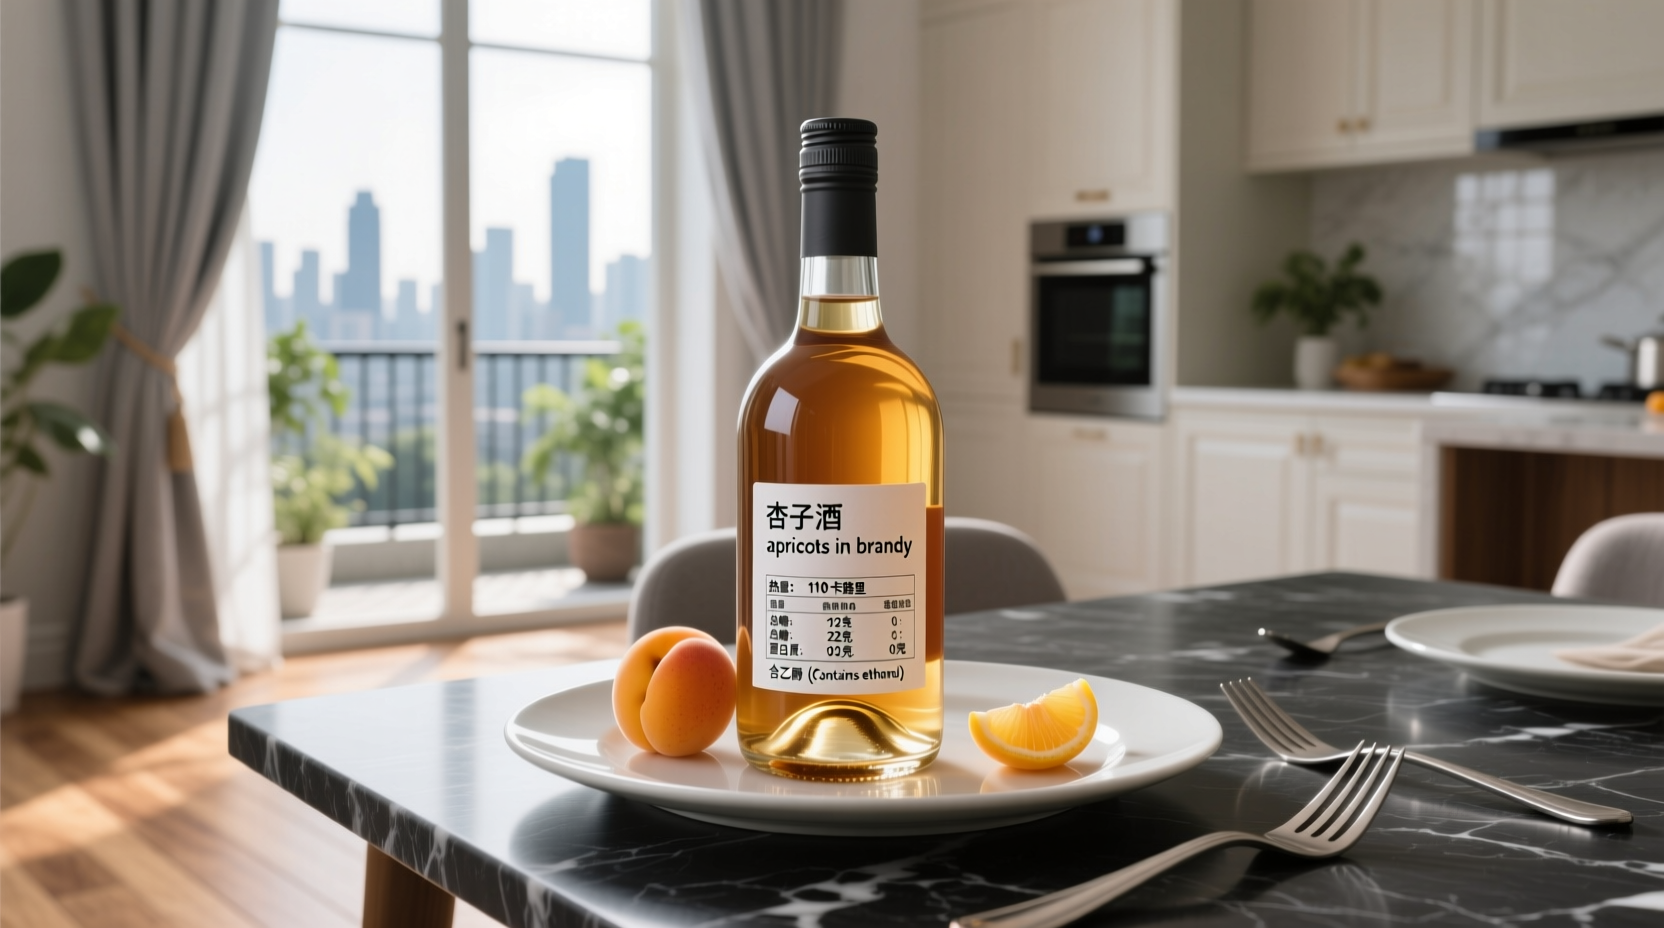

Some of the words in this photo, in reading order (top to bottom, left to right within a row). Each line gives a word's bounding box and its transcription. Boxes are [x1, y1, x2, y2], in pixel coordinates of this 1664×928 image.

[766, 501, 843, 531] 杏子酒
[766, 537, 830, 558] apricots
[835, 537, 851, 554] in
[856, 535, 913, 558] brandy
